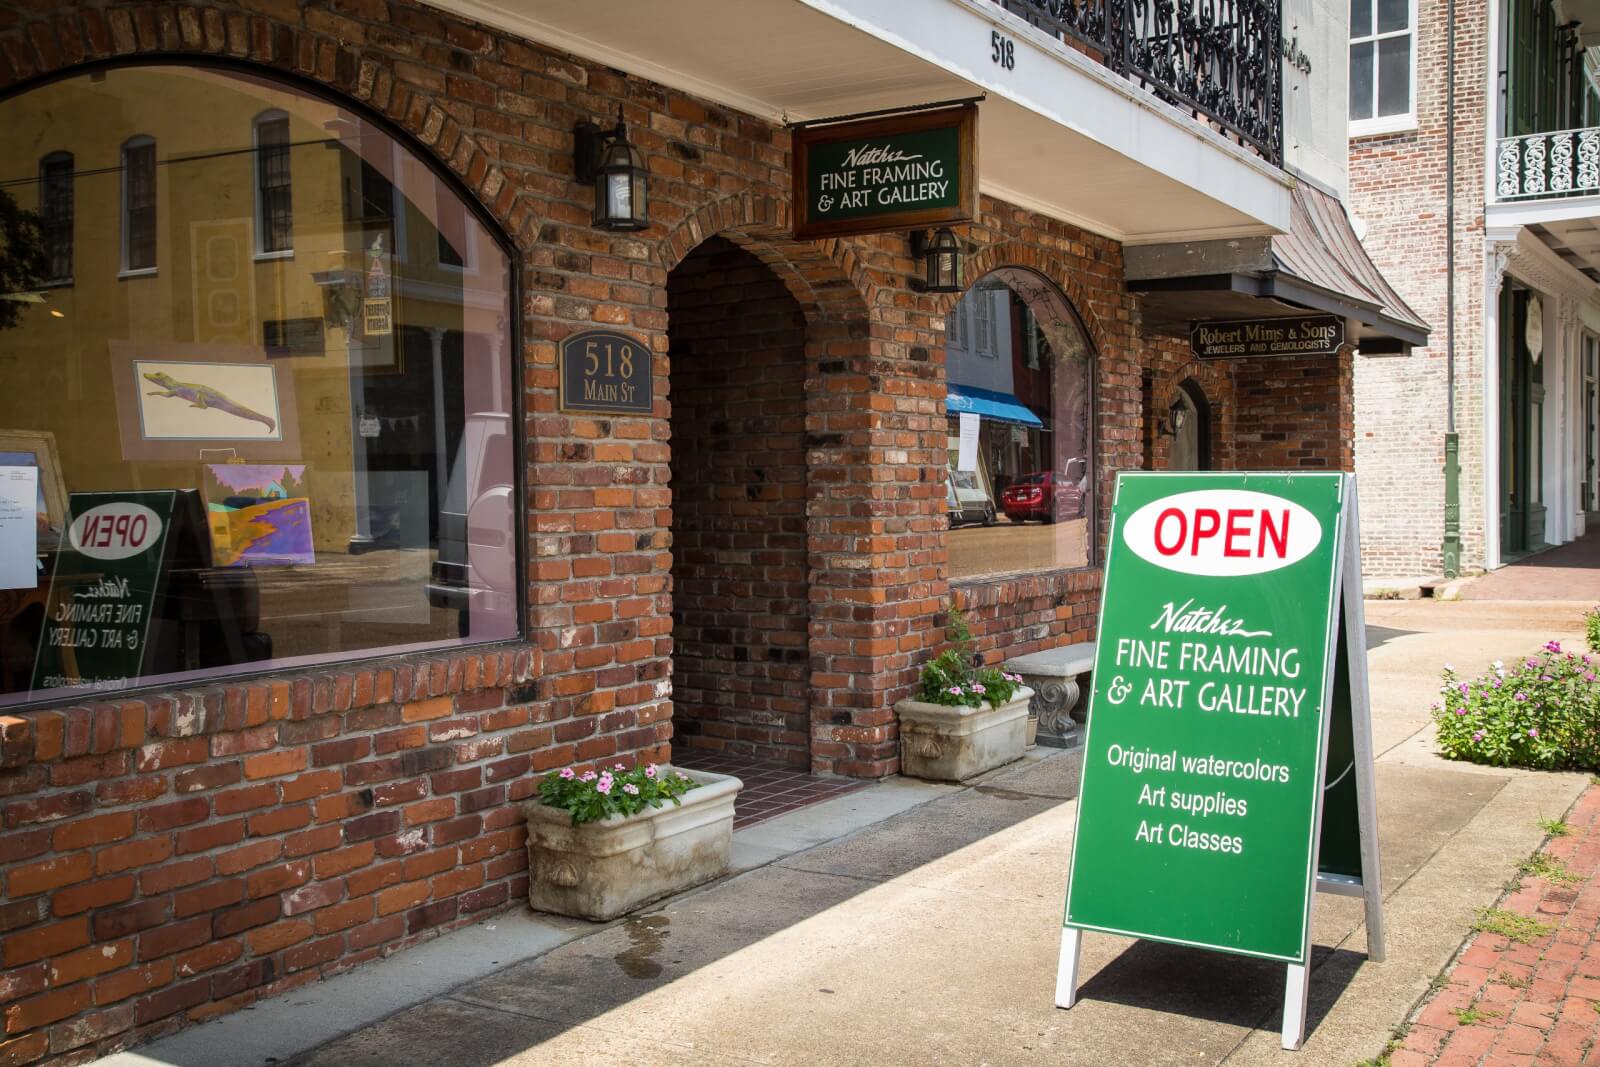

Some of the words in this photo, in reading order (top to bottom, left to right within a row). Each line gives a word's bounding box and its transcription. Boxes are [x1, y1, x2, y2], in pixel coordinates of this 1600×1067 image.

[992, 31, 1014, 71] 518
[841, 144, 923, 168] Natchez
[821, 170, 856, 191] FINE
[863, 160, 943, 186] FRAMING
[818, 195, 834, 212] &
[840, 190, 872, 209] ART
[878, 180, 948, 205] GALLERY
[1200, 327, 1242, 345] Robert
[1246, 324, 1284, 342] Mims
[1288, 328, 1298, 340] &
[1301, 321, 1336, 341] Sons
[1206, 344, 1245, 354] JEWELERS
[1250, 343, 1267, 351] AND
[1271, 340, 1330, 351] GEMOLOGISTS
[585, 341, 633, 379] 518
[584, 379, 617, 402] MAIN
[1154, 507, 1290, 558] OPEN
[1150, 598, 1273, 637] Natchez
[1116, 639, 1170, 669] FINE
[1179, 643, 1300, 678] FRAMING
[1107, 676, 1132, 704] &
[1140, 678, 1190, 708] ART
[1198, 682, 1306, 718] GALLERY
[1107, 744, 1177, 773] Original
[1182, 755, 1290, 783] watercolors
[1138, 784, 1165, 807] Art
[1170, 792, 1247, 817] supplies
[1135, 820, 1163, 844] Art
[1168, 824, 1243, 854] Classes
